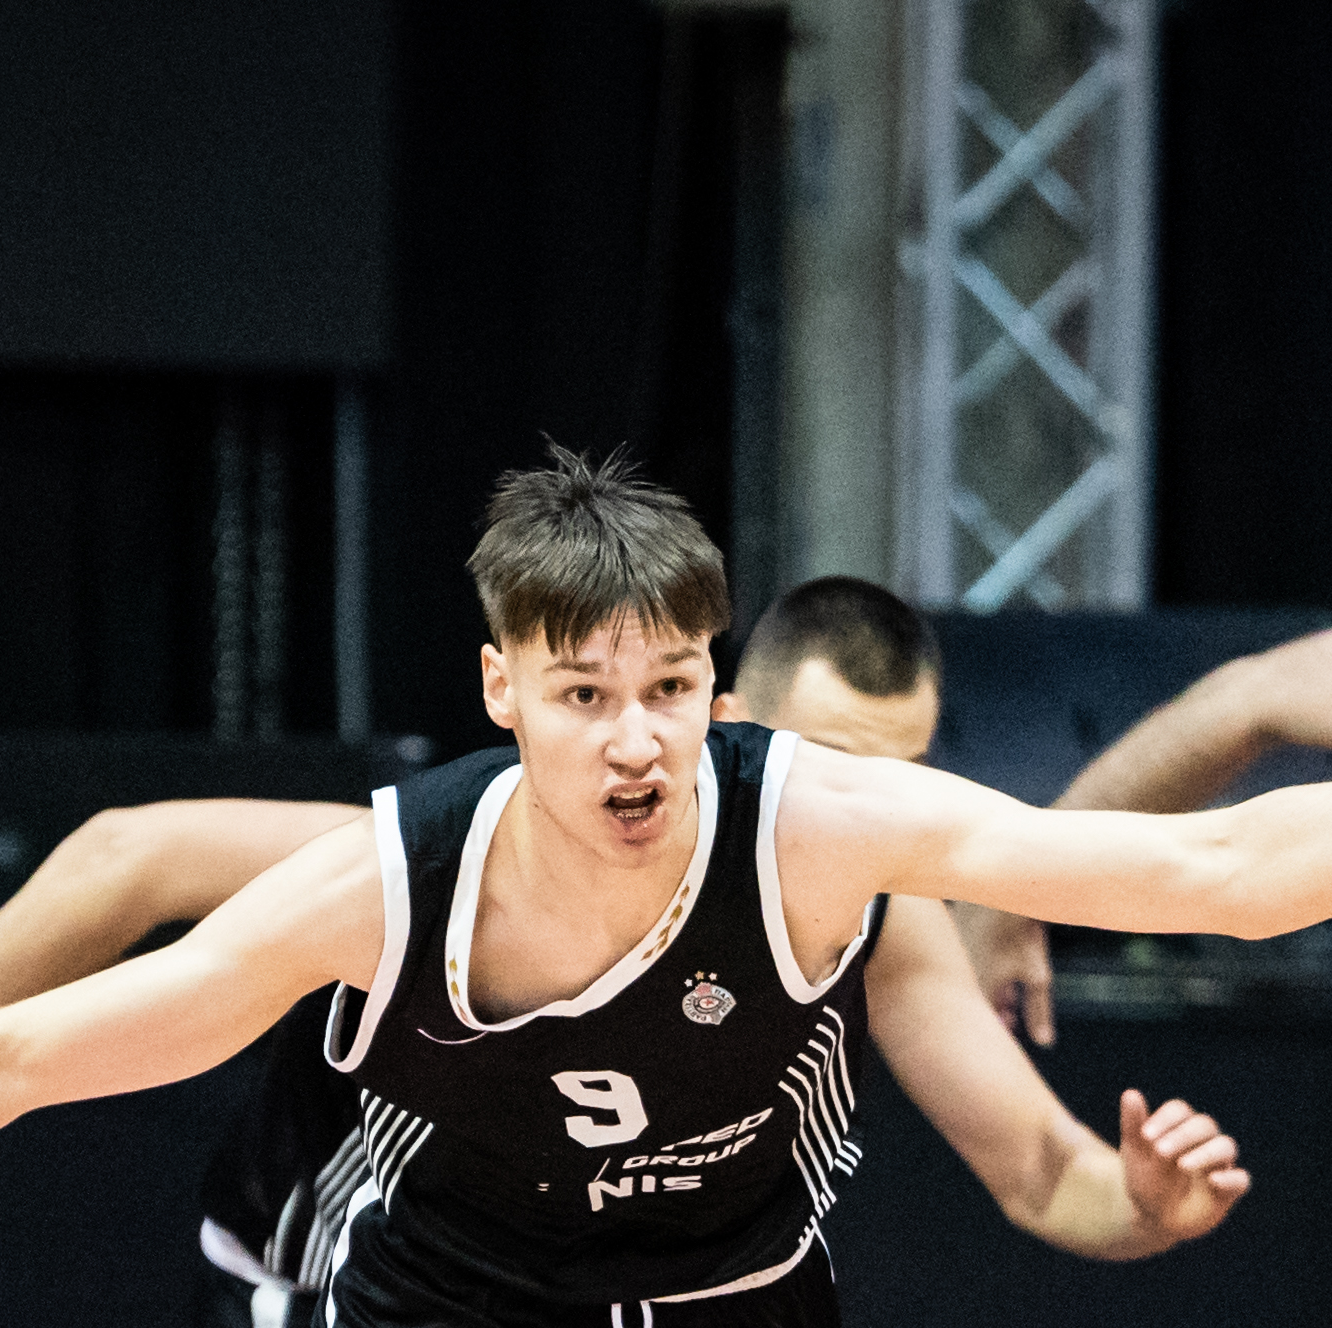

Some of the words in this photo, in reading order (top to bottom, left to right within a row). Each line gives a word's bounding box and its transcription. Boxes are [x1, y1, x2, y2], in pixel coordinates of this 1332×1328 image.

[550, 1070, 649, 1149] 9
[622, 1132, 756, 1169] GROUP
[587, 1174, 703, 1212] NIS
